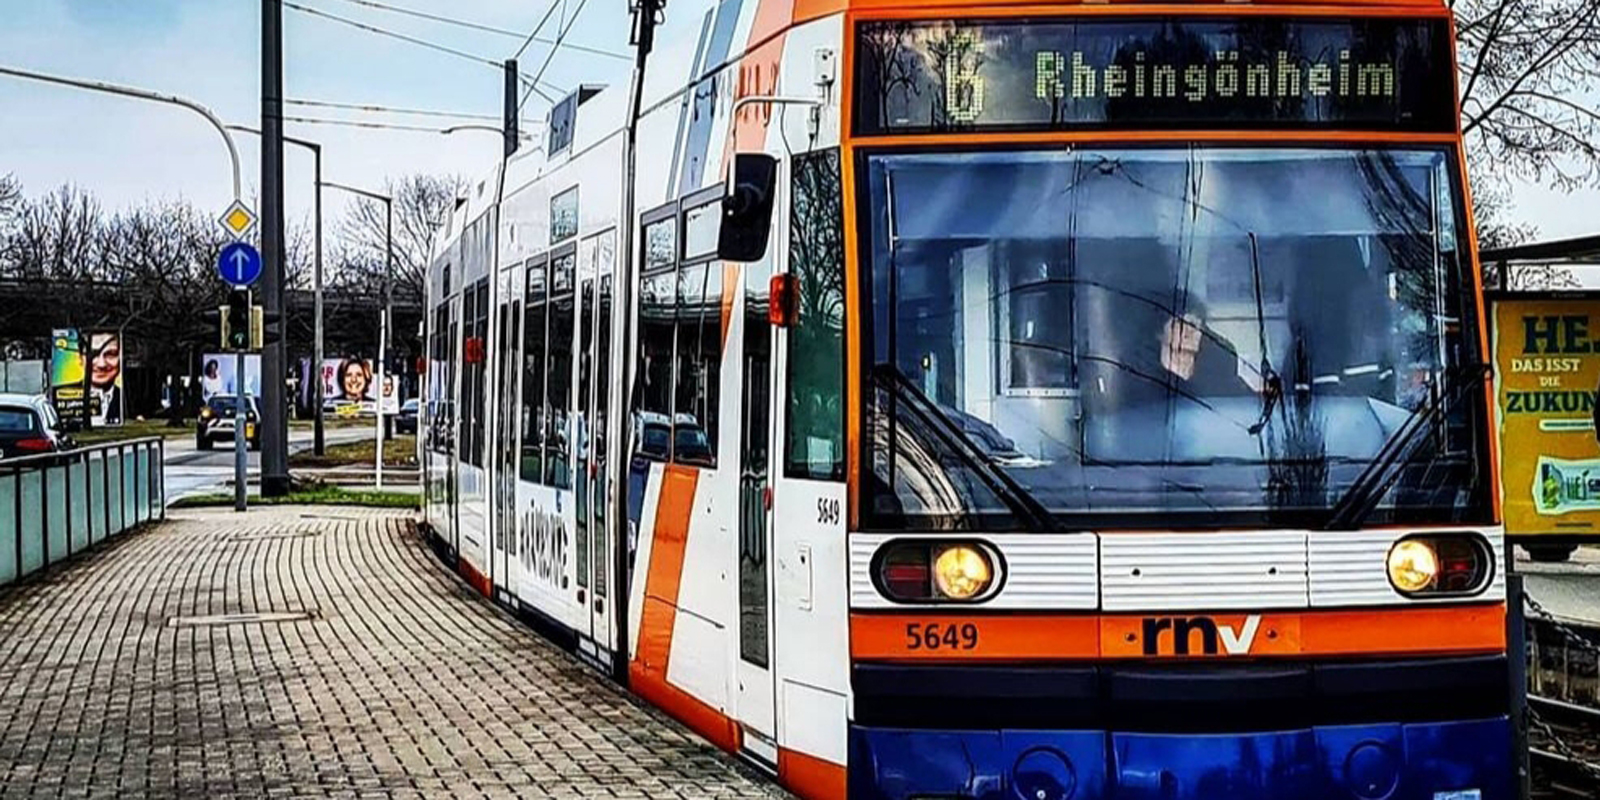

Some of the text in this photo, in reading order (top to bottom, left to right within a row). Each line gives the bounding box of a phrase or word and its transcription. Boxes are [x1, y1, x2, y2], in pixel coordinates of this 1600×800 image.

[946, 33, 1395, 121] 6 Rheingönheim
[1511, 358, 1581, 373] DAS ISST
[1539, 376, 1561, 387] DIE
[817, 497, 840, 525] 5649
[906, 622, 979, 650] 5649
[1142, 614, 1261, 655] rnv
